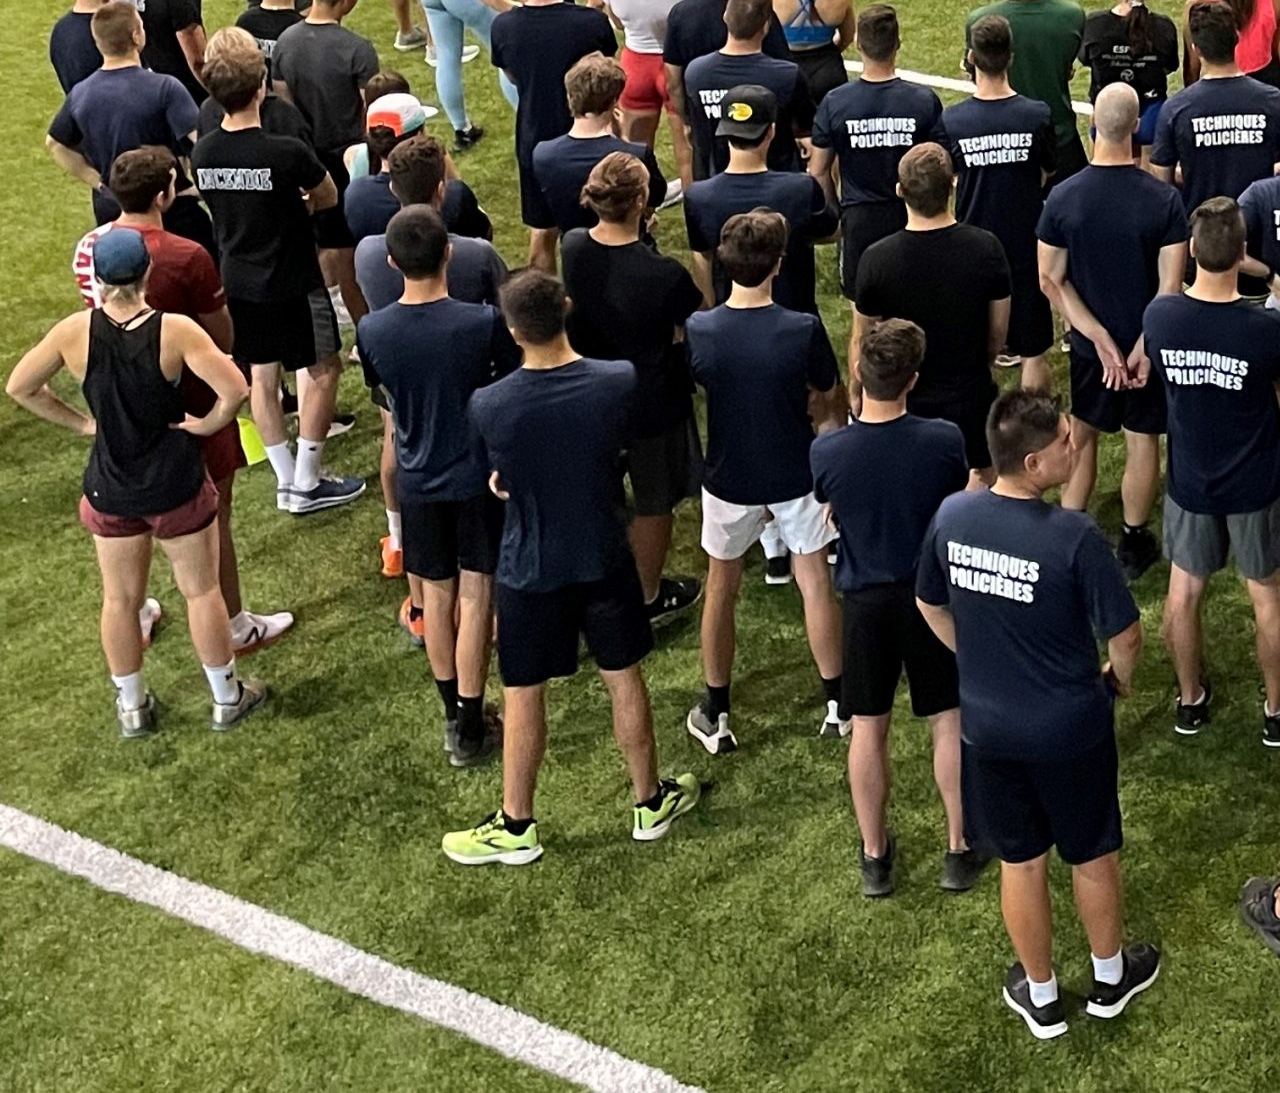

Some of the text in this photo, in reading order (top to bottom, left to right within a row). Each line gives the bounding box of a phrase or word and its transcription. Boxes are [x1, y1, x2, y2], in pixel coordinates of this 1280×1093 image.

[845, 117, 917, 134] TECHNIQUES
[1191, 114, 1267, 132] TECHNIQUES
[958, 133, 1033, 153] TECHNIQUES
[196, 168, 273, 191] INCENDIE
[1160, 349, 1249, 376] TECHNIQUES
[947, 540, 1040, 583] TECHNIQUES
[949, 565, 1034, 604] POLICIÈRES
